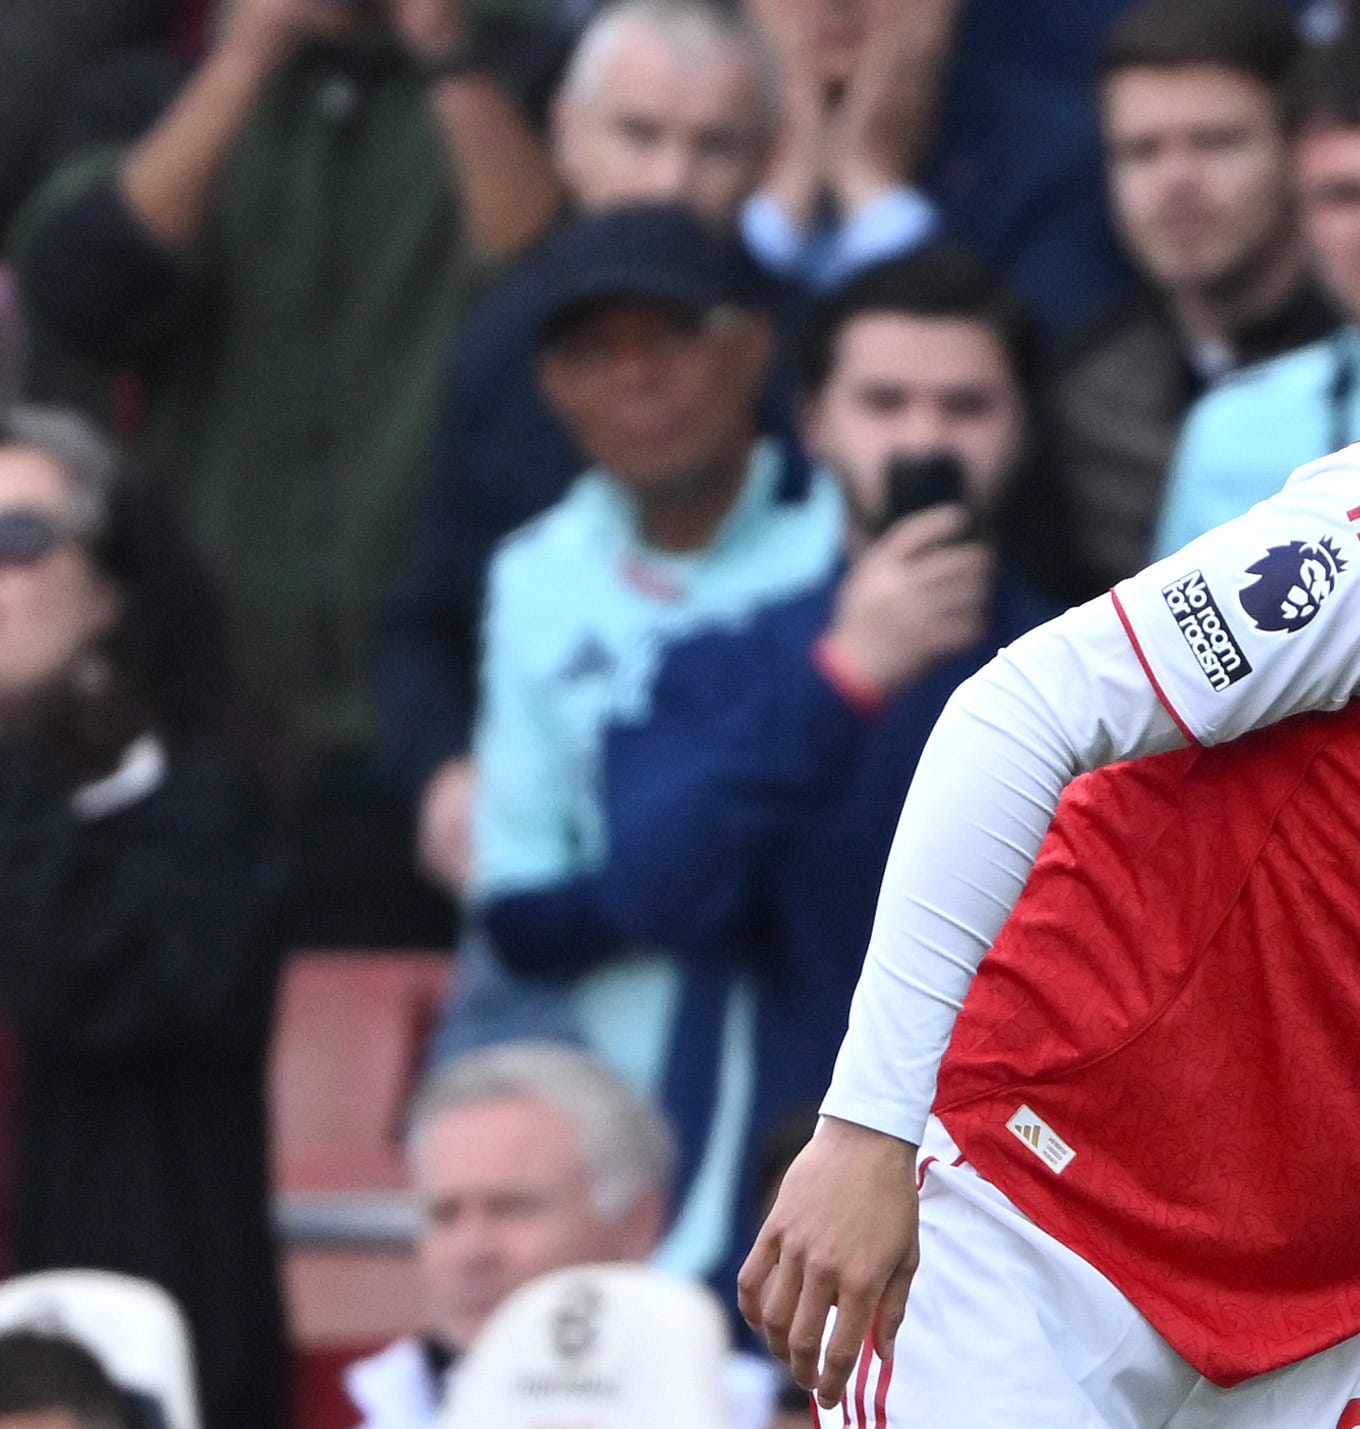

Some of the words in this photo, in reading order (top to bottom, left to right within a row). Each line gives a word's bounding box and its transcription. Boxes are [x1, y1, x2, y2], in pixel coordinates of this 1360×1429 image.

[1179, 615, 1230, 691] racism
[1182, 570, 1207, 608] No
[1197, 606, 1241, 672] room
